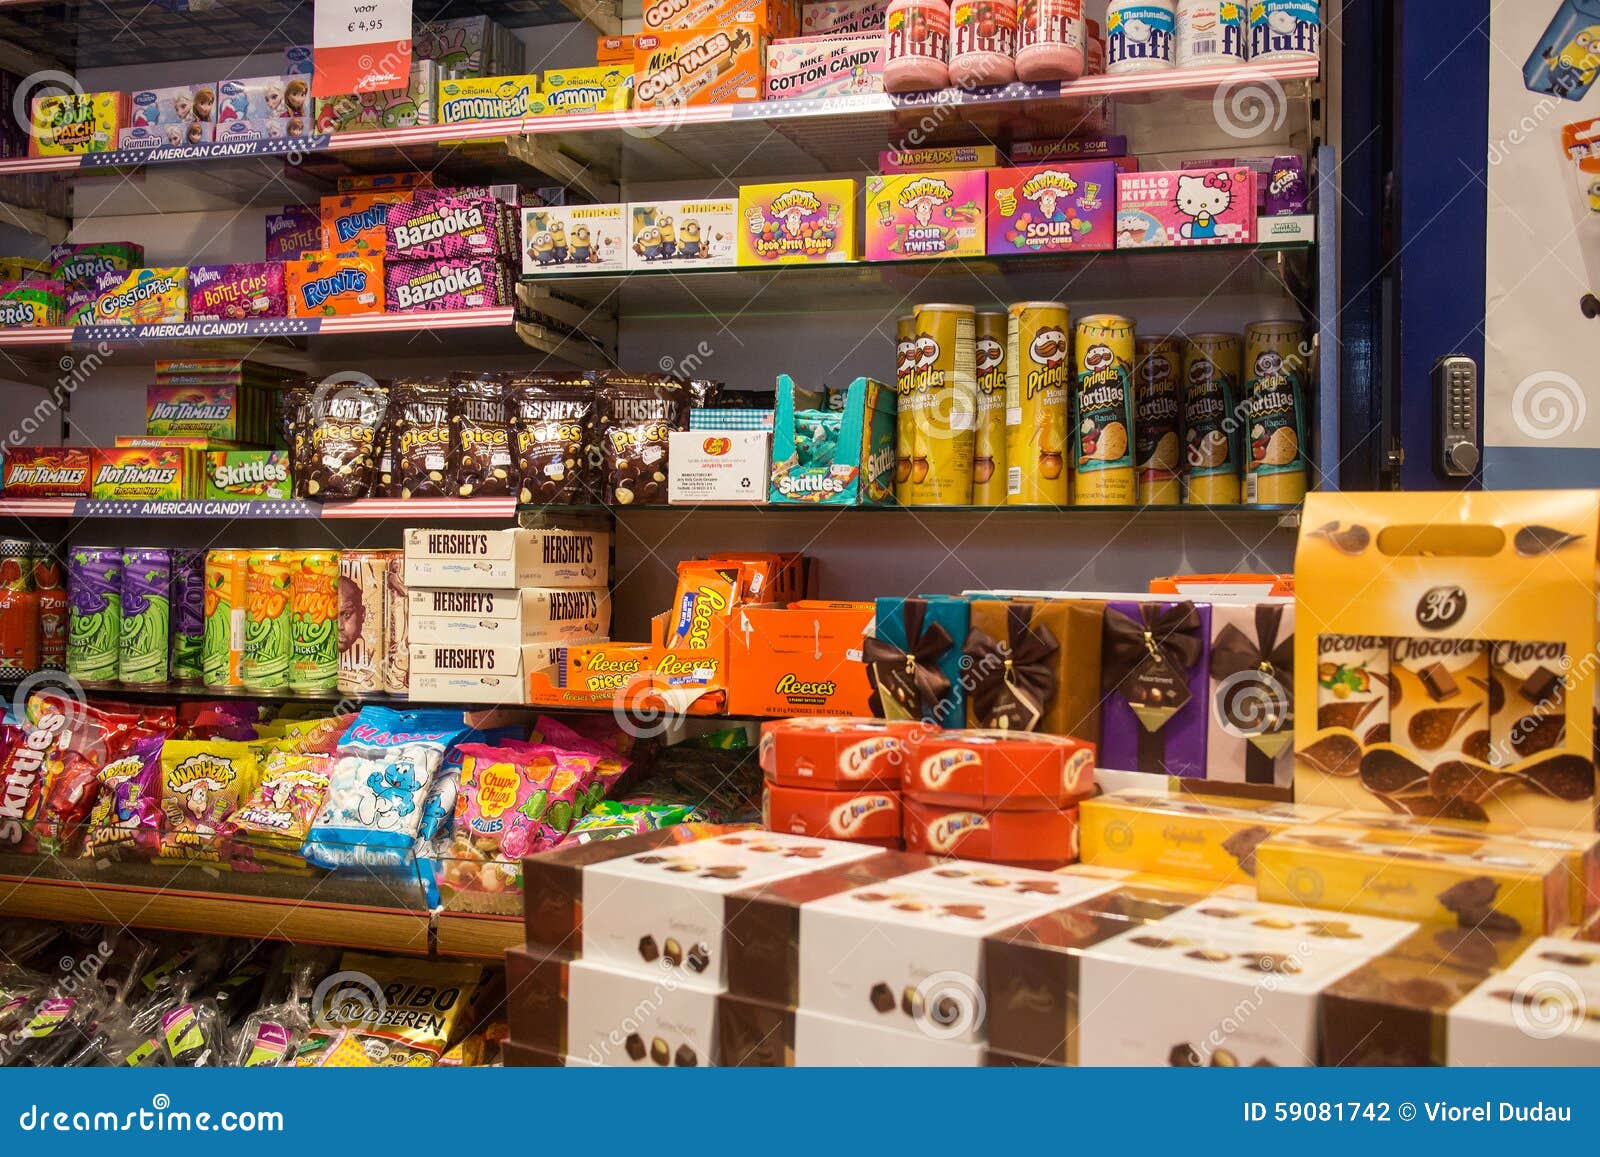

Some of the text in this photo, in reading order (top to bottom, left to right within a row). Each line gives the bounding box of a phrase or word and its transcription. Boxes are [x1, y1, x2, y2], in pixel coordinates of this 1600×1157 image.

[354, 4, 378, 14] voor
[833, 11, 856, 26] MIKE
[862, 11, 887, 28] CAN
[348, 19, 383, 32] € 4,95
[1108, 29, 1172, 65] fluff
[1252, 20, 1318, 57] fluff
[638, 62, 682, 101] COW
[678, 32, 732, 74] TALES
[648, 46, 678, 75] Mini
[800, 46, 848, 69] MIKE IKE
[769, 65, 827, 92] COTTON
[830, 50, 880, 75] CANDY
[566, 79, 598, 87] ORIGINAL
[904, 89, 964, 106] CANDY!
[52, 120, 96, 140] PATCH
[122, 136, 163, 150] Gummies
[148, 142, 257, 161] AMERICAN CANDY!
[1121, 177, 1169, 191] HELLO
[1270, 170, 1299, 195] Crush
[1121, 189, 1169, 202] KITTY
[336, 203, 387, 242] RUNT
[394, 208, 484, 250] Bazooka
[407, 212, 441, 228] ORIGINAL
[1027, 221, 1071, 237] SOUR
[908, 229, 941, 240] SOUR
[904, 240, 947, 252] TWISTS
[240, 274, 268, 295] CAPS
[302, 267, 368, 309] RUNTS
[396, 265, 484, 309] Bazooka
[409, 272, 442, 287] ORIGINAL
[139, 322, 249, 338] AMERICAN CANDY!
[1082, 368, 1119, 393] Pringles
[1078, 385, 1124, 409] Tortillas
[150, 402, 232, 421] HOT TAMALES
[1094, 413, 1118, 422] Ranch
[6, 465, 87, 486] HOT TAMALES
[96, 465, 178, 486] HOT TAMALES
[214, 460, 289, 488] Skittles
[779, 473, 845, 495] Skittles
[141, 503, 250, 515] AMERICAN CANDY!
[428, 534, 488, 554] HERSHEY'S
[543, 535, 593, 564] HERSHEY'S
[433, 591, 494, 613] HERSHEY'S
[549, 591, 597, 621] HERSHEY'S
[689, 585, 726, 650] Reese
[434, 648, 495, 669] HERSHEY'S
[587, 652, 641, 673] Reese's
[776, 674, 836, 696] Reese's
[0, 713, 66, 845] Skittles
[168, 760, 236, 788] WARHEADS
[484, 772, 516, 790] Chupa
[480, 785, 512, 803] Chups
[469, 818, 503, 834] JELLIES
[323, 1002, 447, 1038] GOUDBEREN
